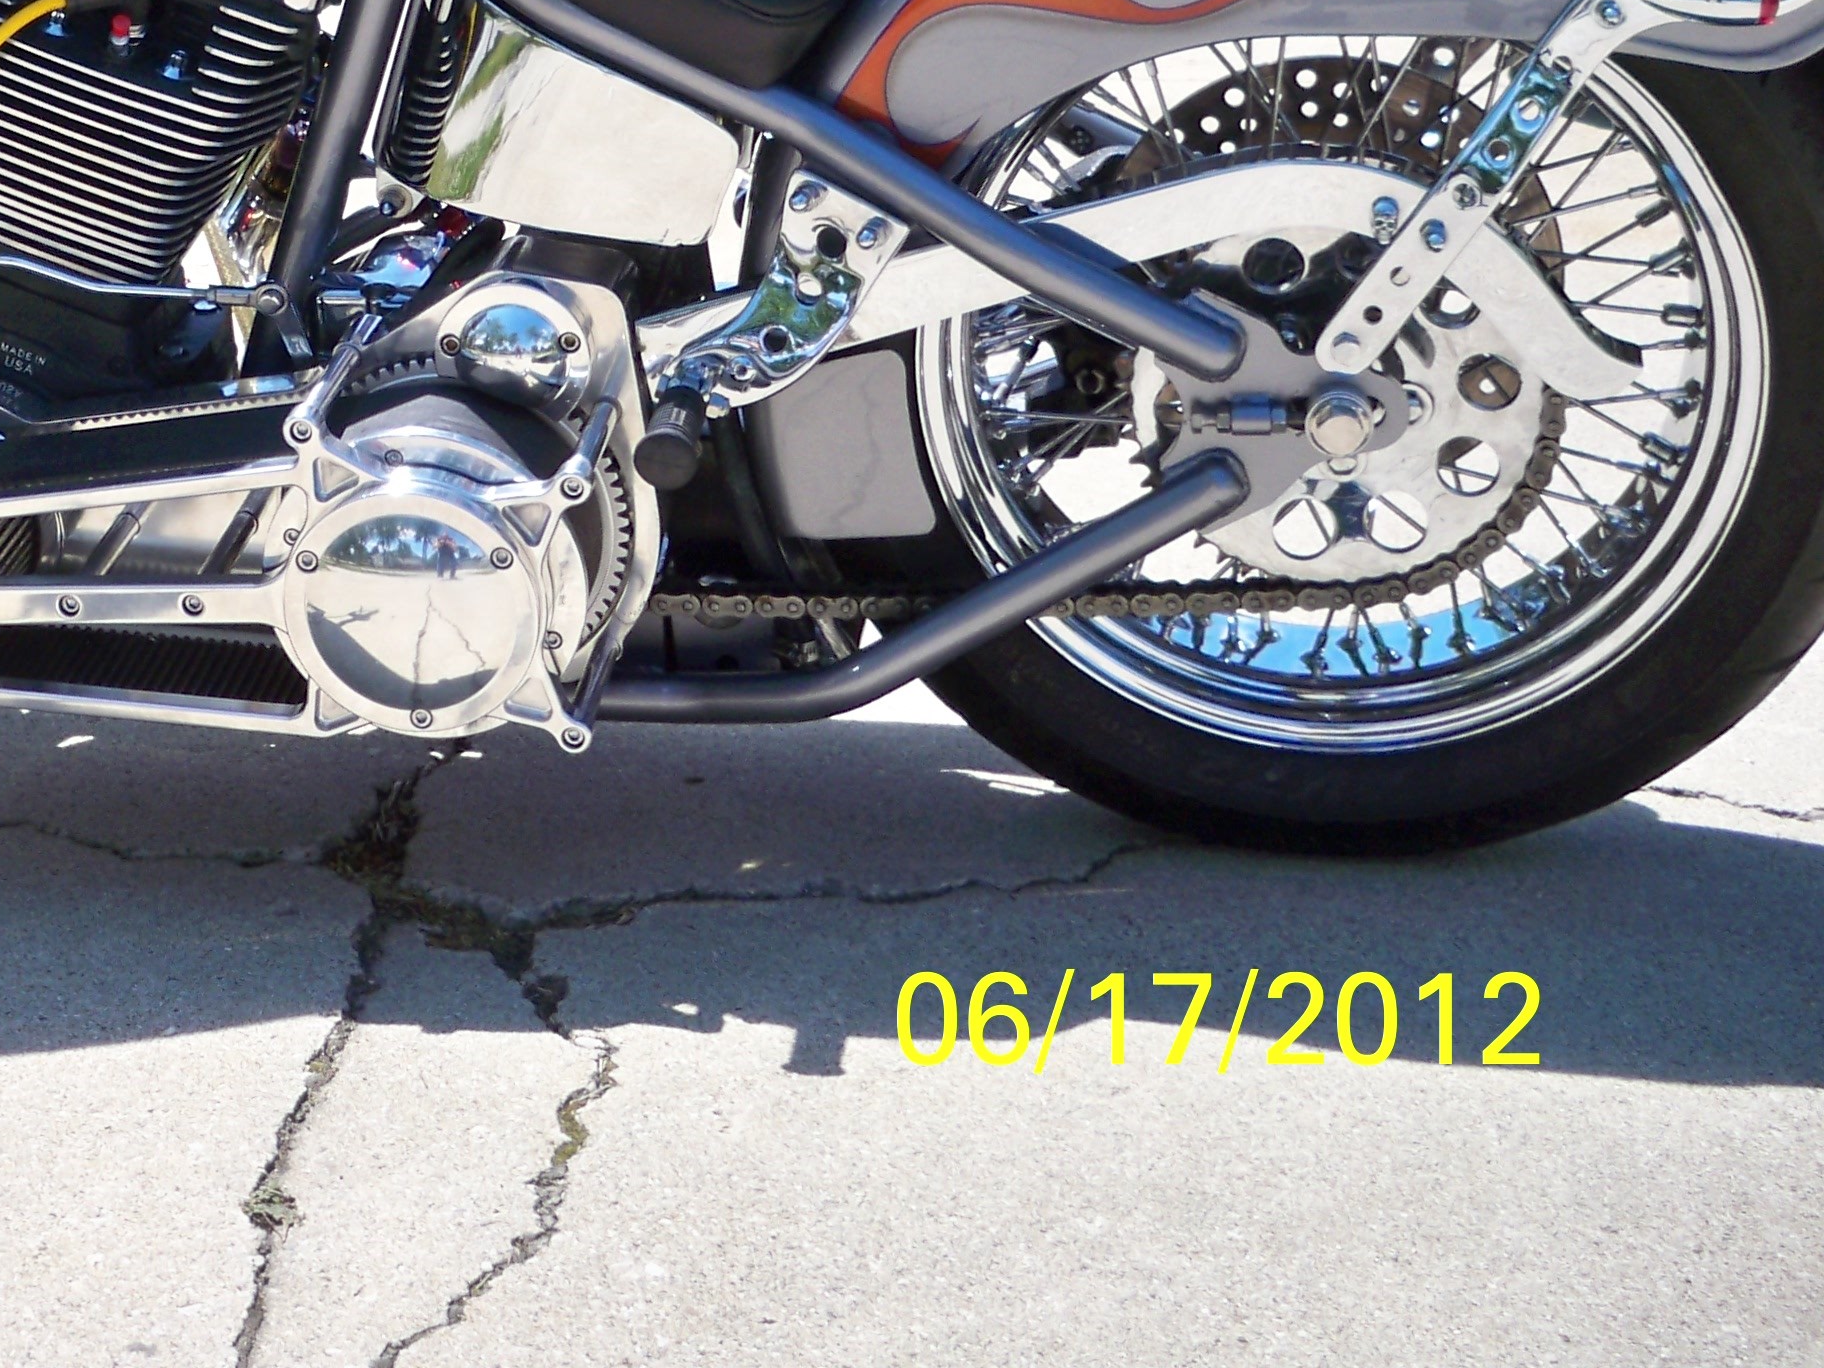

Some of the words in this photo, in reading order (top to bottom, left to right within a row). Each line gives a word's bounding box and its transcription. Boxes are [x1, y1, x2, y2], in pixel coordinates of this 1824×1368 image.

[1, 342, 33, 362] MADE
[35, 355, 47, 366] IN
[4, 355, 33, 376] USA
